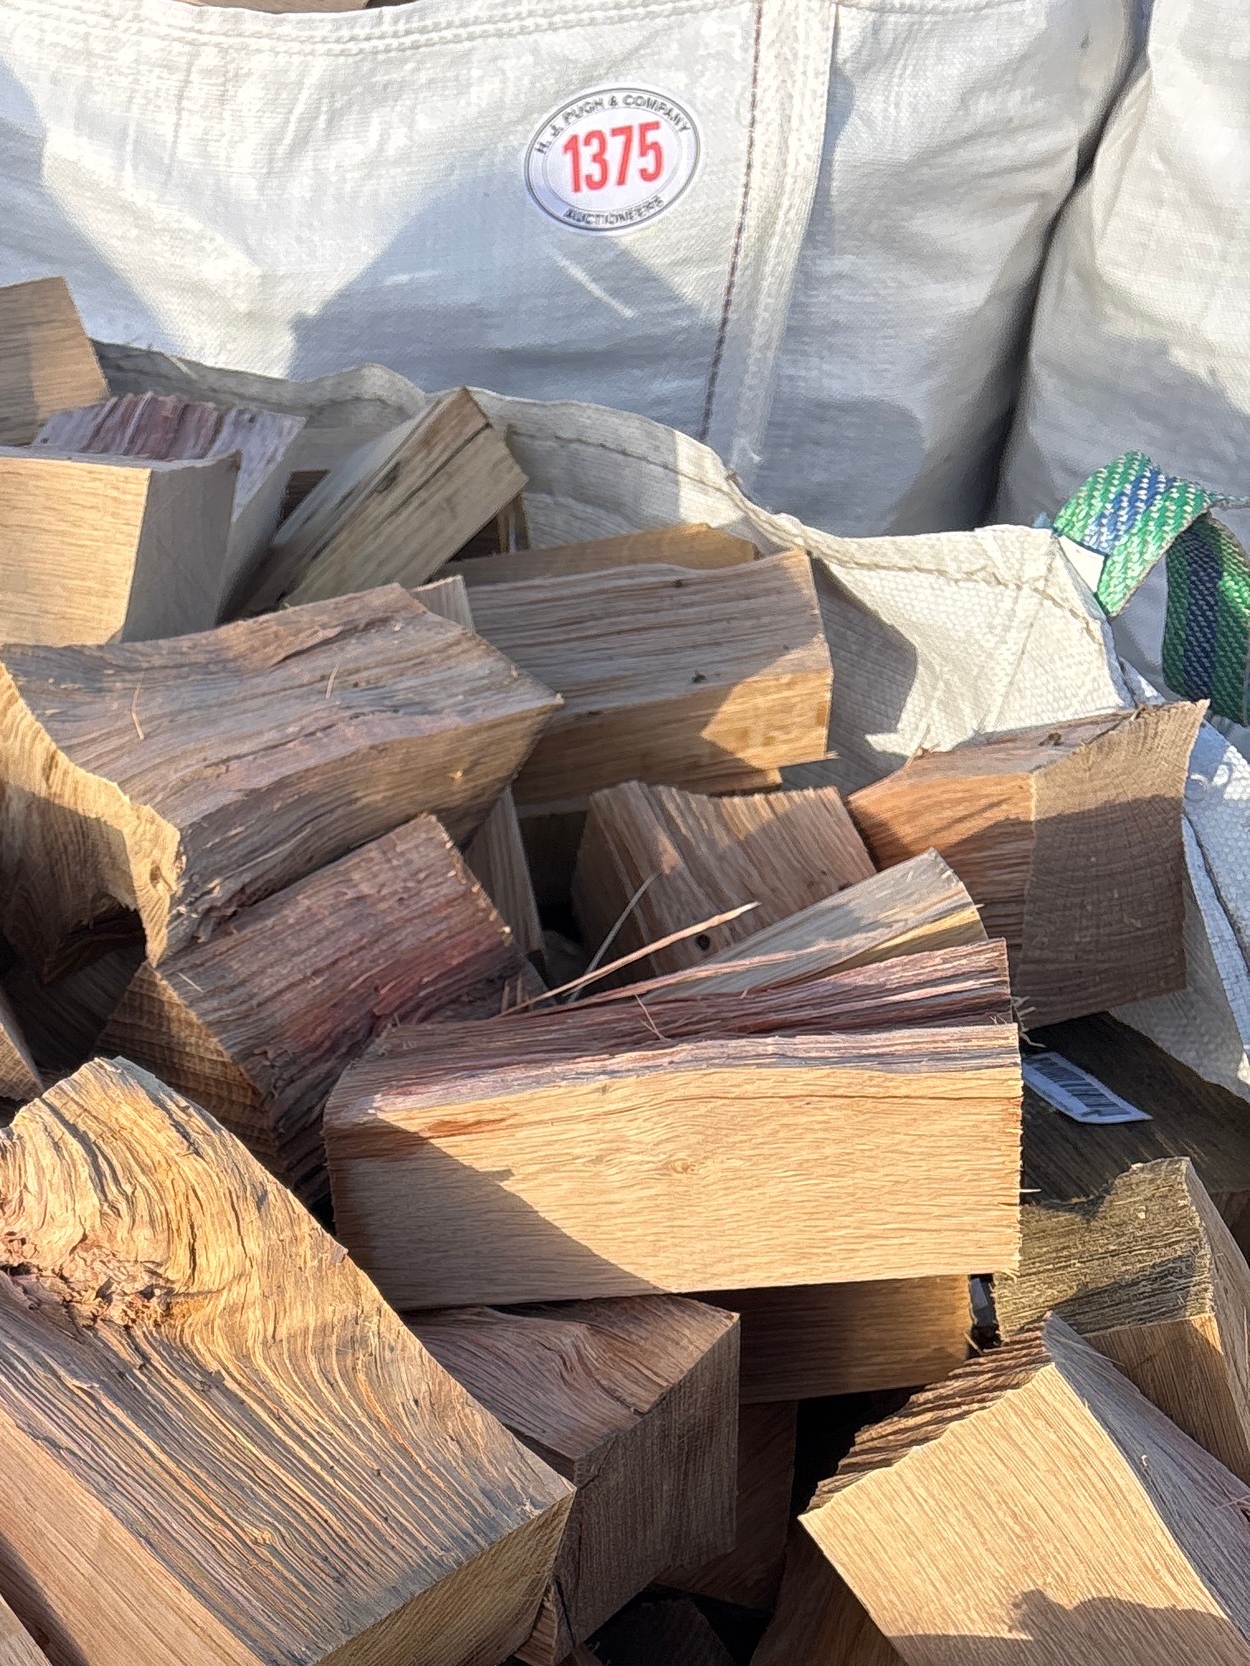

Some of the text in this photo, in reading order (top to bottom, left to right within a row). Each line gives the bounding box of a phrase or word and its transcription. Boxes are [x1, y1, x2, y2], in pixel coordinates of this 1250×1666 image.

[562, 97, 605, 126] PUGH
[608, 95, 619, 107] &
[622, 94, 691, 133] COMPANY
[563, 120, 664, 194] 1375
[563, 194, 665, 225] AUCTIONEERS
